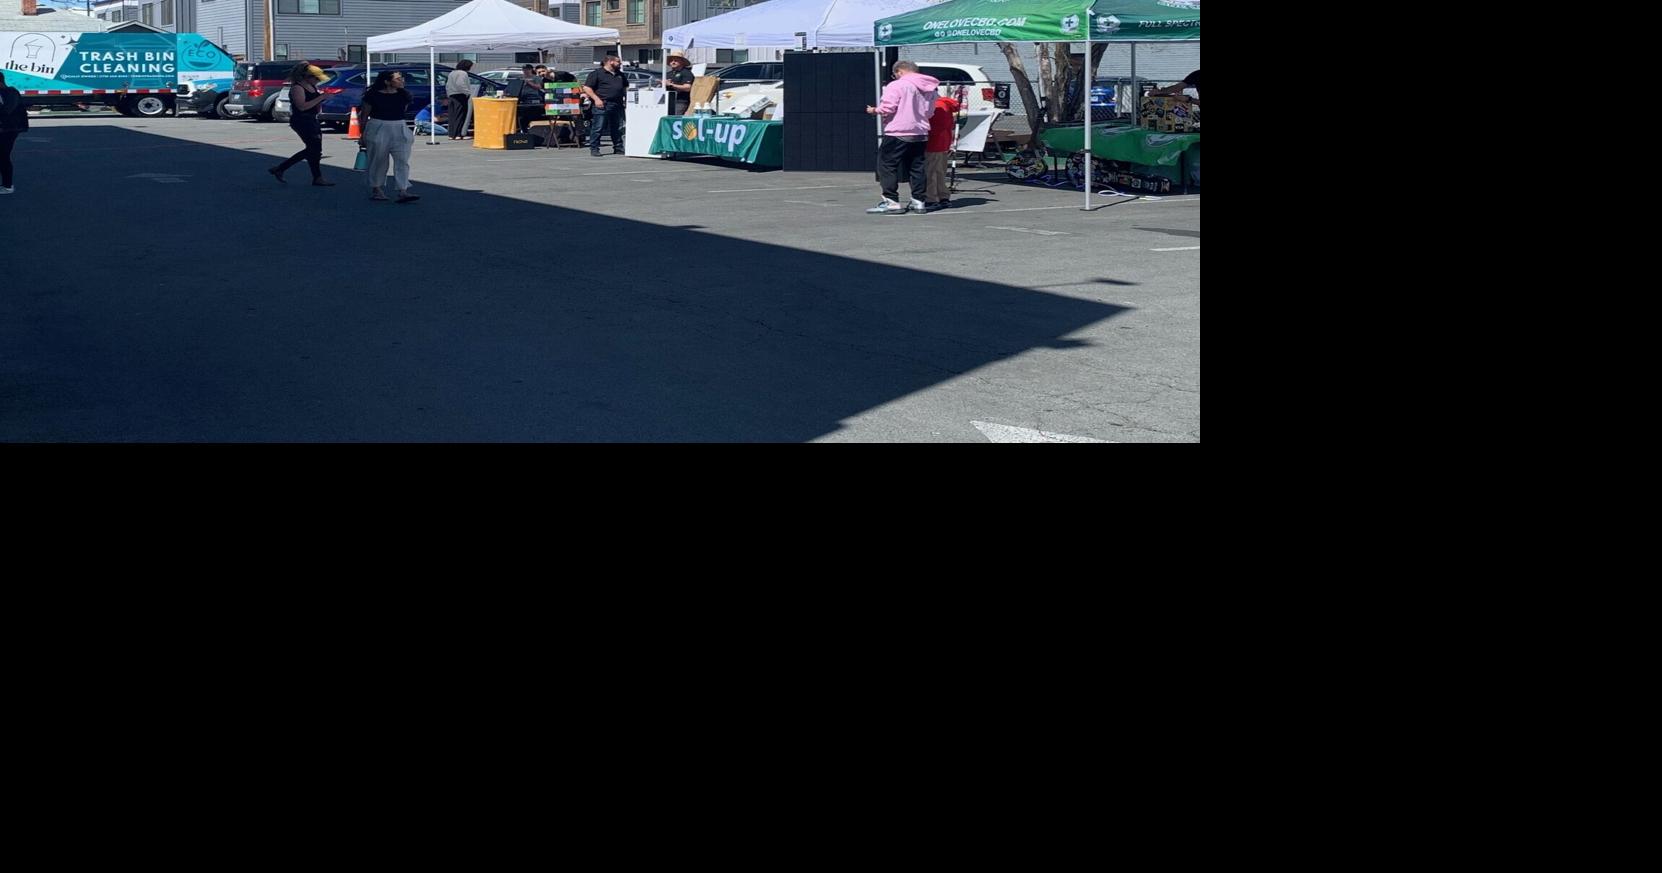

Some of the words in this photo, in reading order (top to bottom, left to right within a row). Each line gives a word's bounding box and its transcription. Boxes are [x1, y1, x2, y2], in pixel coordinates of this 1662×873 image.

[923, 17, 1027, 30] ONELOVECBD.COM
[1138, 20, 1161, 28] FULL
[79, 51, 138, 62] TRASH
[144, 51, 175, 62] BIN
[188, 49, 216, 59] ECO
[5, 60, 28, 71] the
[31, 62, 54, 74] bin
[80, 63, 175, 73] CLEANING
